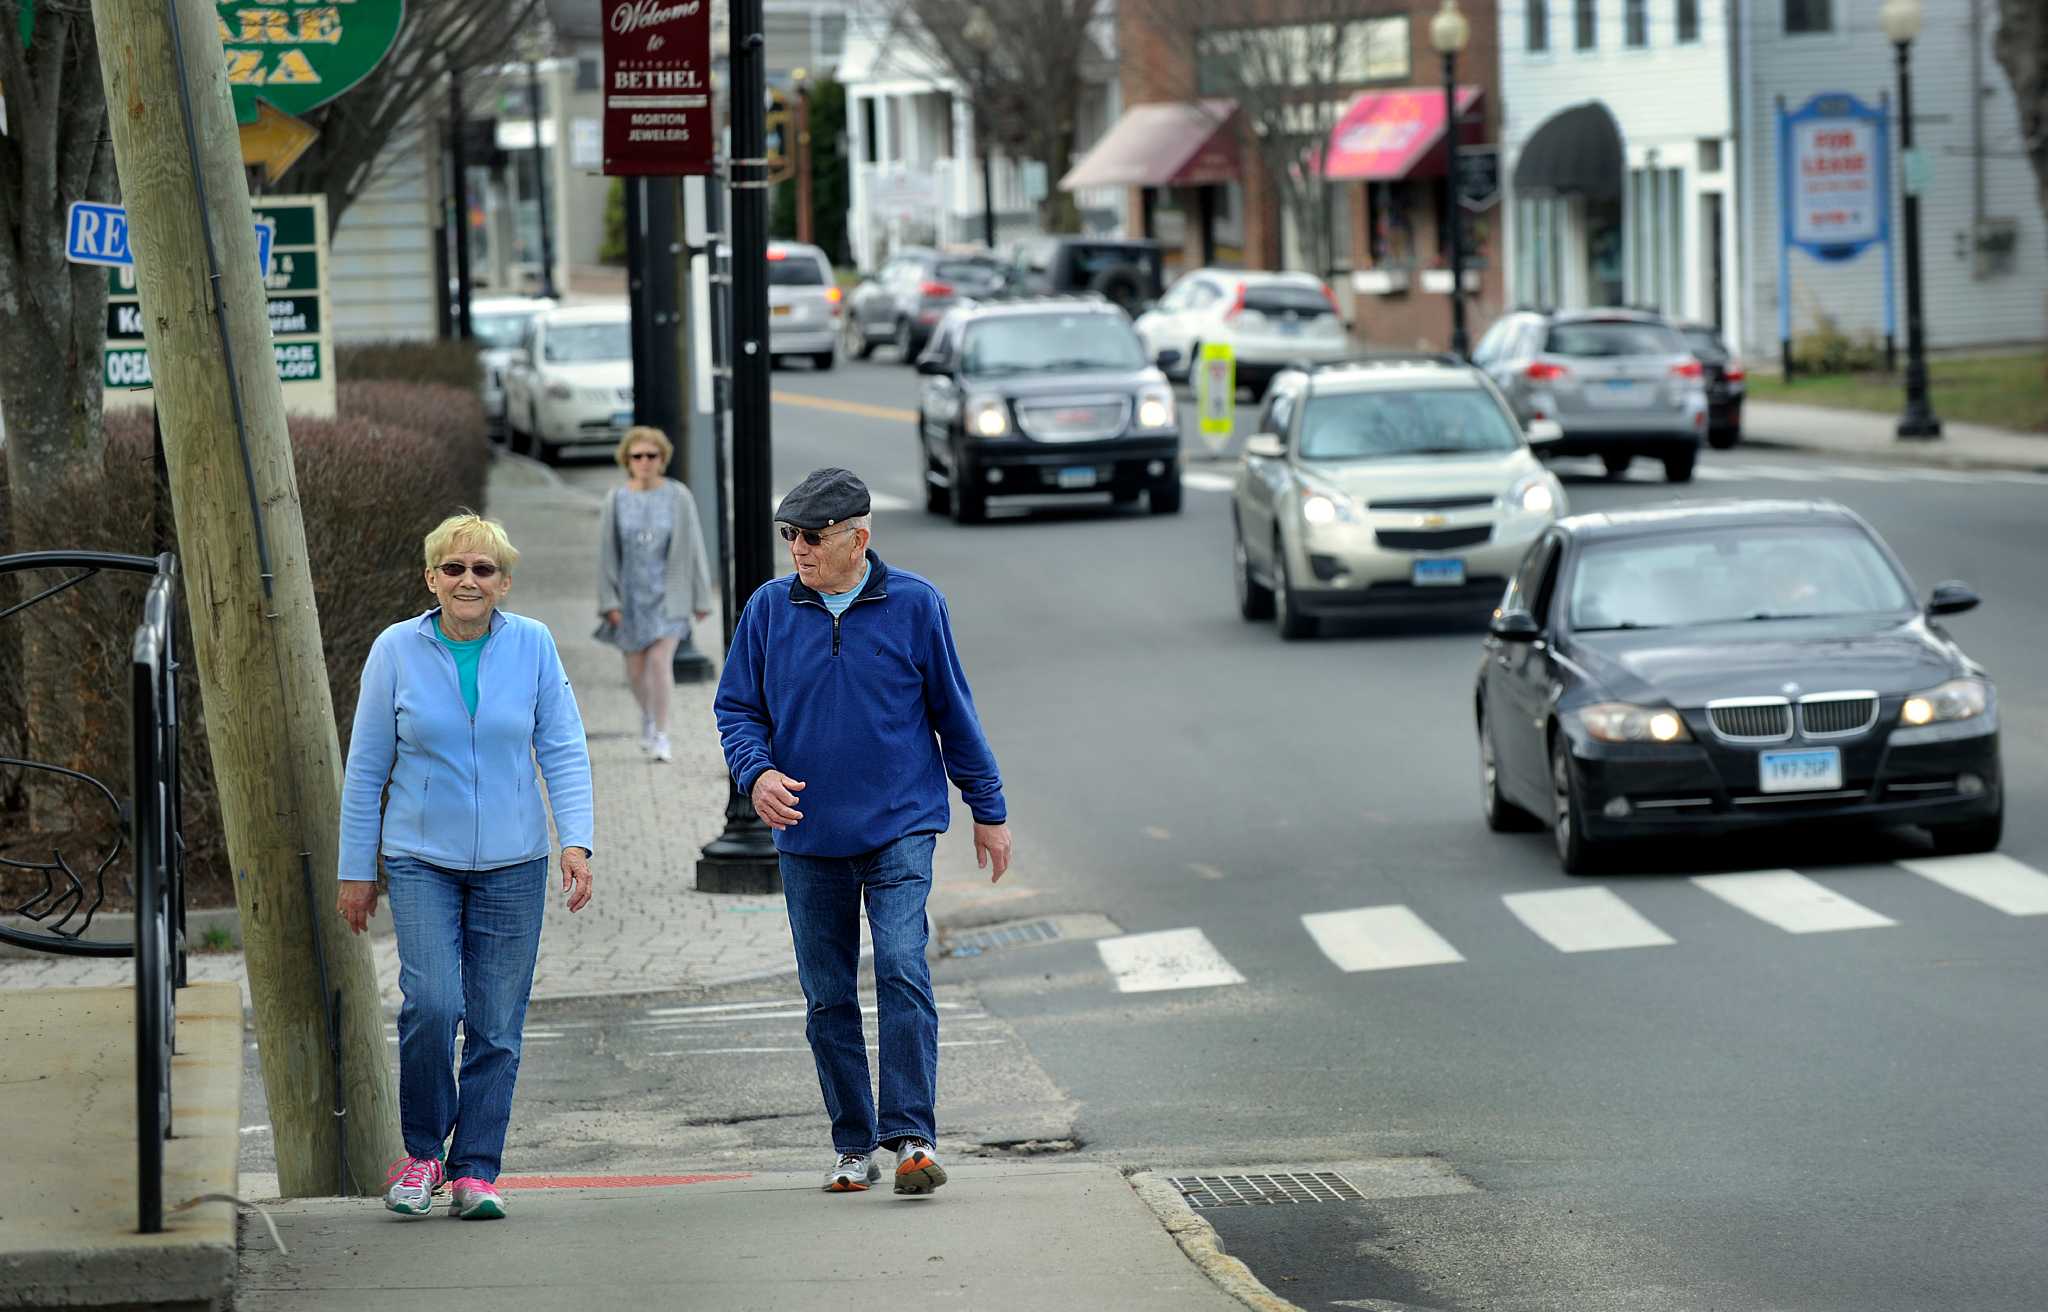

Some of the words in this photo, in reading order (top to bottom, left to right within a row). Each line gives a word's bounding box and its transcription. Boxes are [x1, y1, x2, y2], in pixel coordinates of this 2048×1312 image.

[611, 0, 700, 34] Welcome
[647, 34, 664, 51] to
[615, 70, 702, 89] BETHEL
[631, 113, 686, 125] MORTON
[628, 129, 689, 141] JEWELERS
